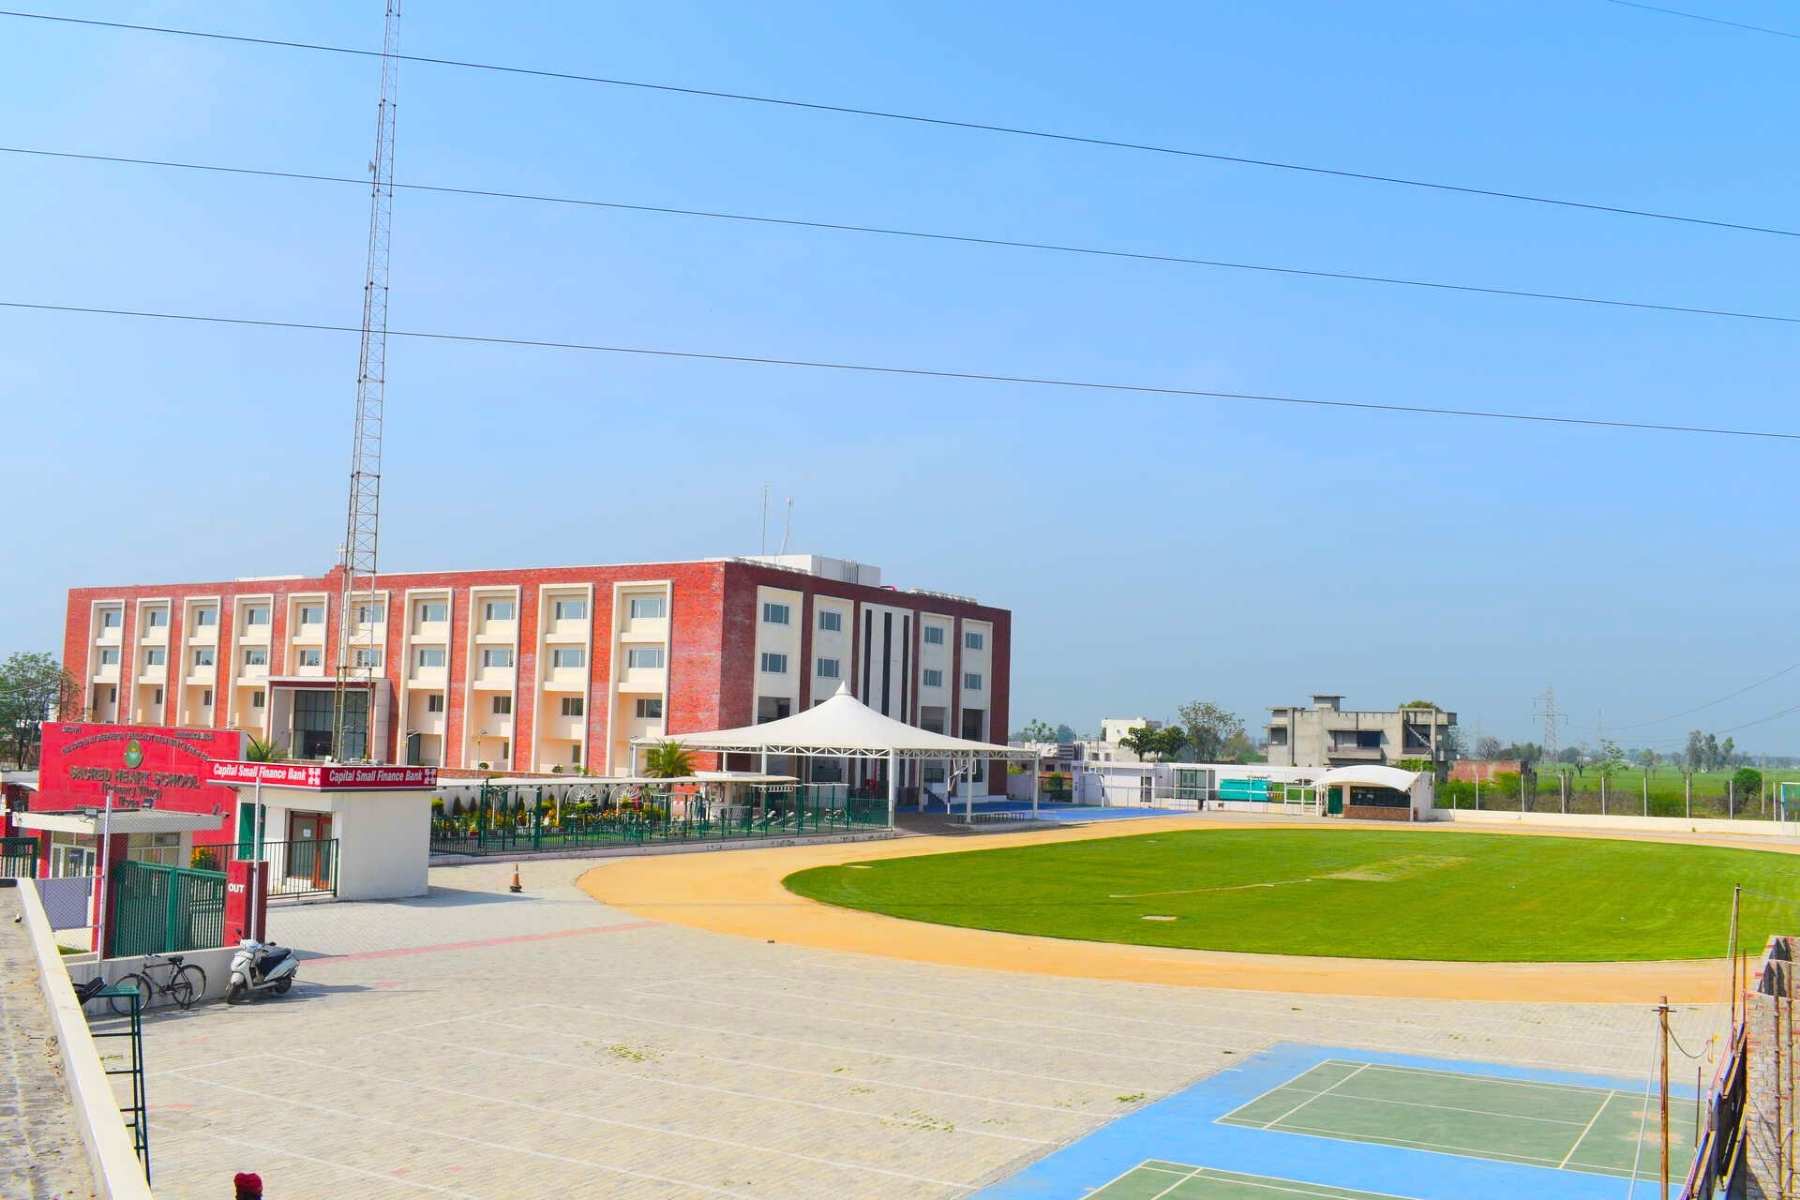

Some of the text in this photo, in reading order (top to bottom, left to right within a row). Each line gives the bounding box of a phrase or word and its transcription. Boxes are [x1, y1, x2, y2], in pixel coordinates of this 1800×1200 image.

[71, 766, 112, 782] SACRED
[154, 771, 200, 788] SCHOOL
[213, 763, 306, 780] Capital Small Finance Bank
[329, 770, 423, 784] Capital Small Finance Bank
[228, 883, 245, 893] OUT
